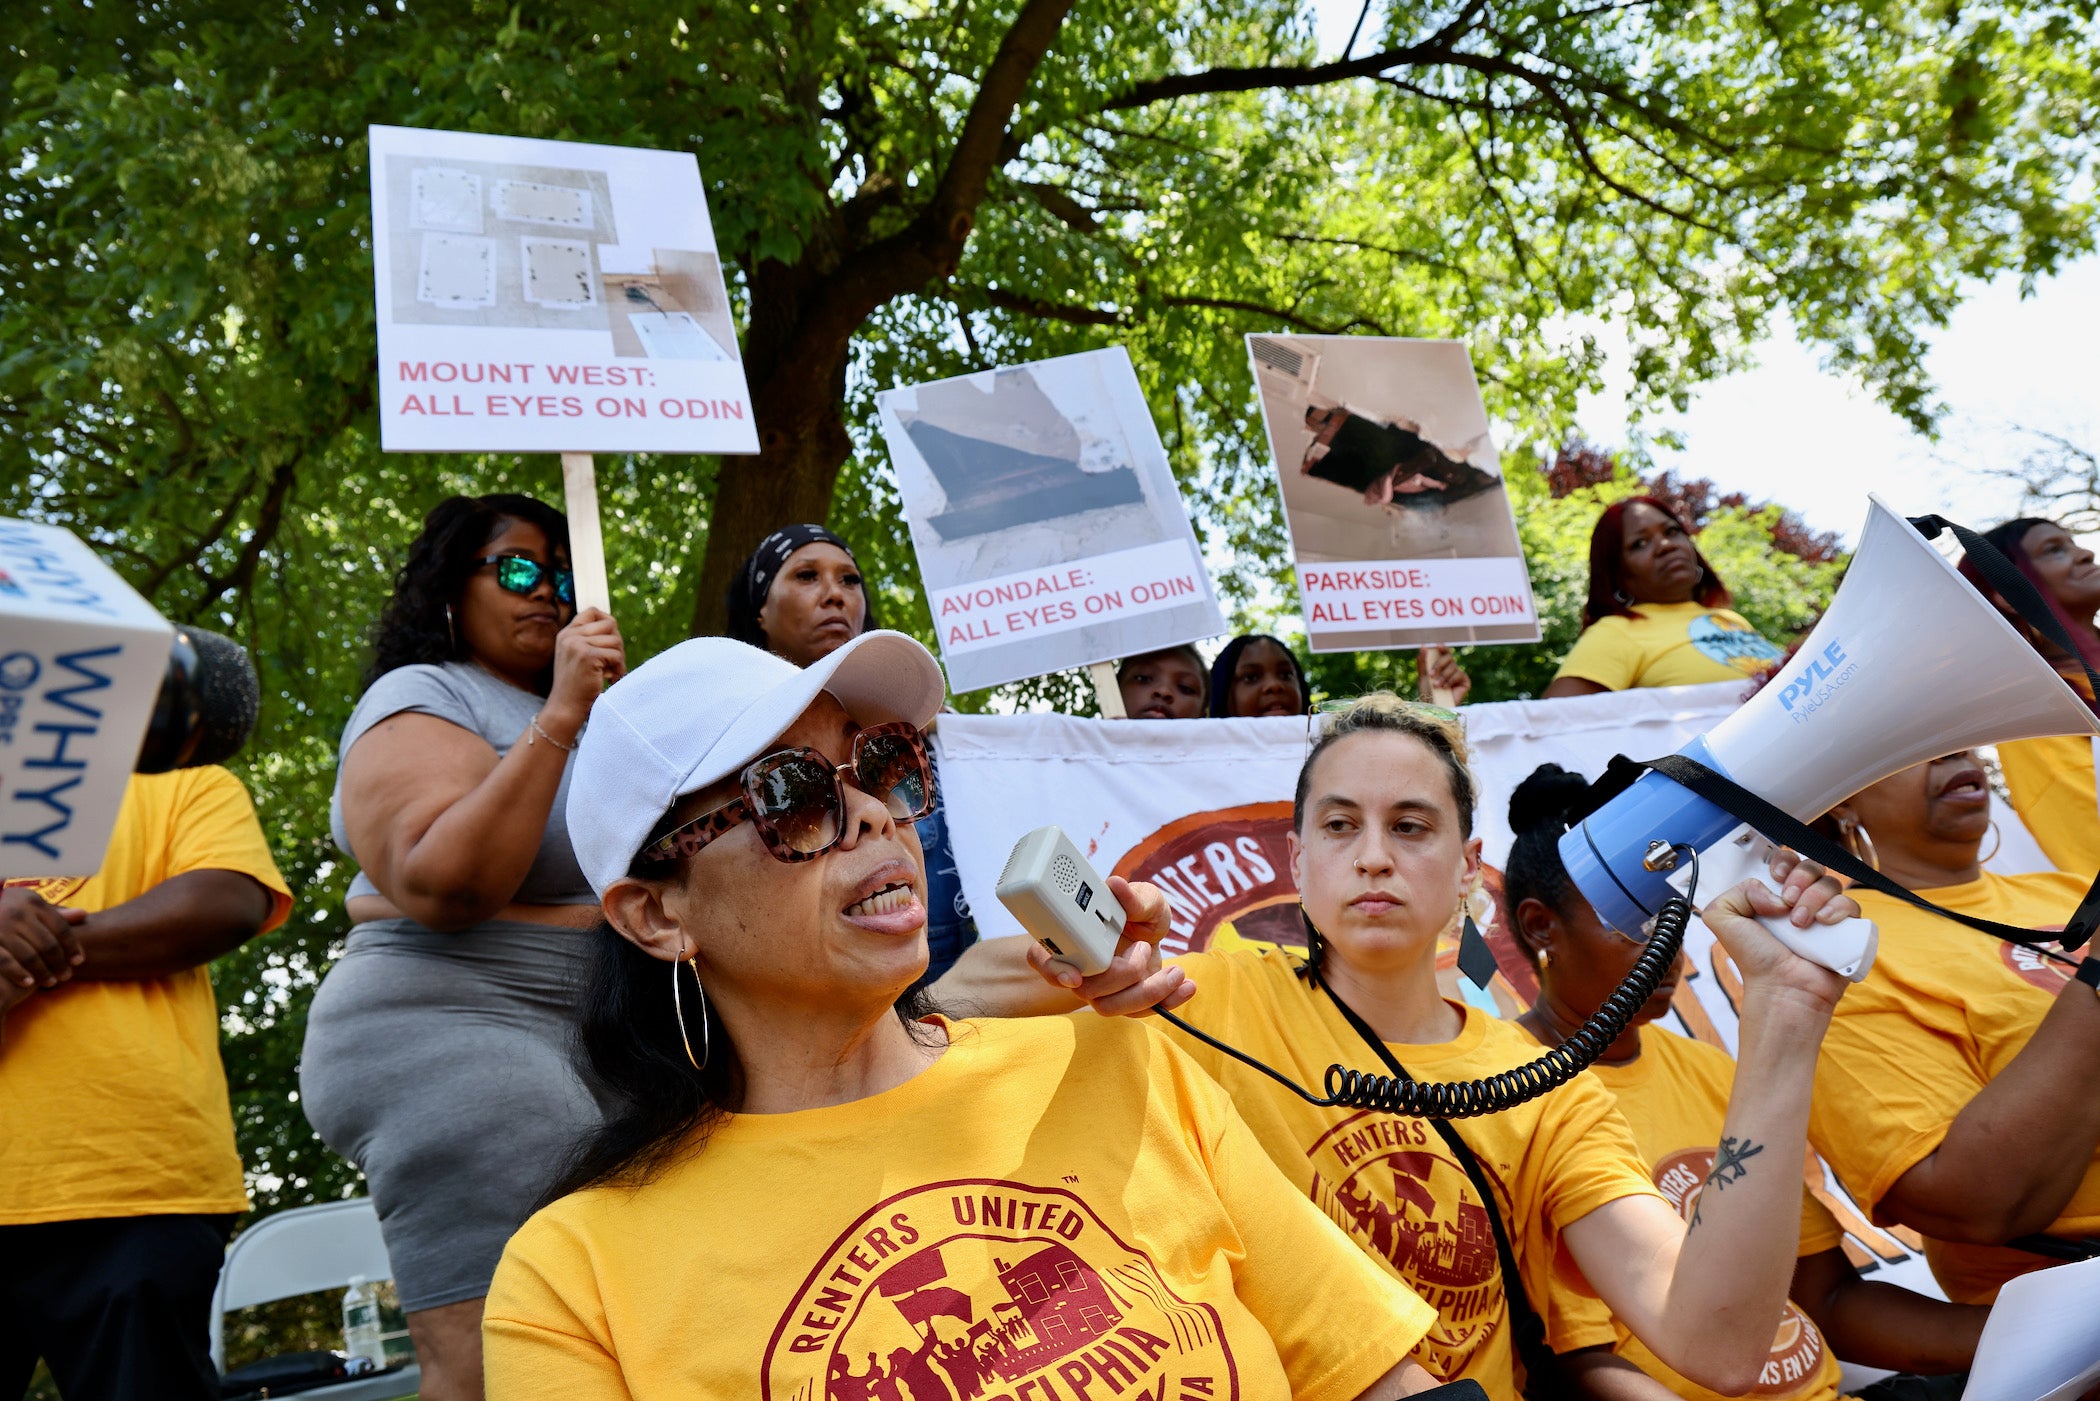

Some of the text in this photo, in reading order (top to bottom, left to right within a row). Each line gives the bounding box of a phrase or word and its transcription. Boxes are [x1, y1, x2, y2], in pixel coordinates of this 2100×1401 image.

[399, 361, 656, 387] MOUNT WEST:
[400, 394, 744, 420] ALL EYES ON ODIN
[941, 568, 1095, 617] AVONDALE:
[1304, 569, 1431, 592] PARKSIDE:
[949, 575, 1196, 646] ALL EYES ON ODIN
[1311, 595, 1526, 623] ALL EYES ON ODIN
[1777, 640, 1847, 712] PYLE
[1791, 662, 1858, 724] PyleUSA.com
[0, 645, 124, 859] WHYY
[789, 1195, 1084, 1353] RENTERS UNITED
